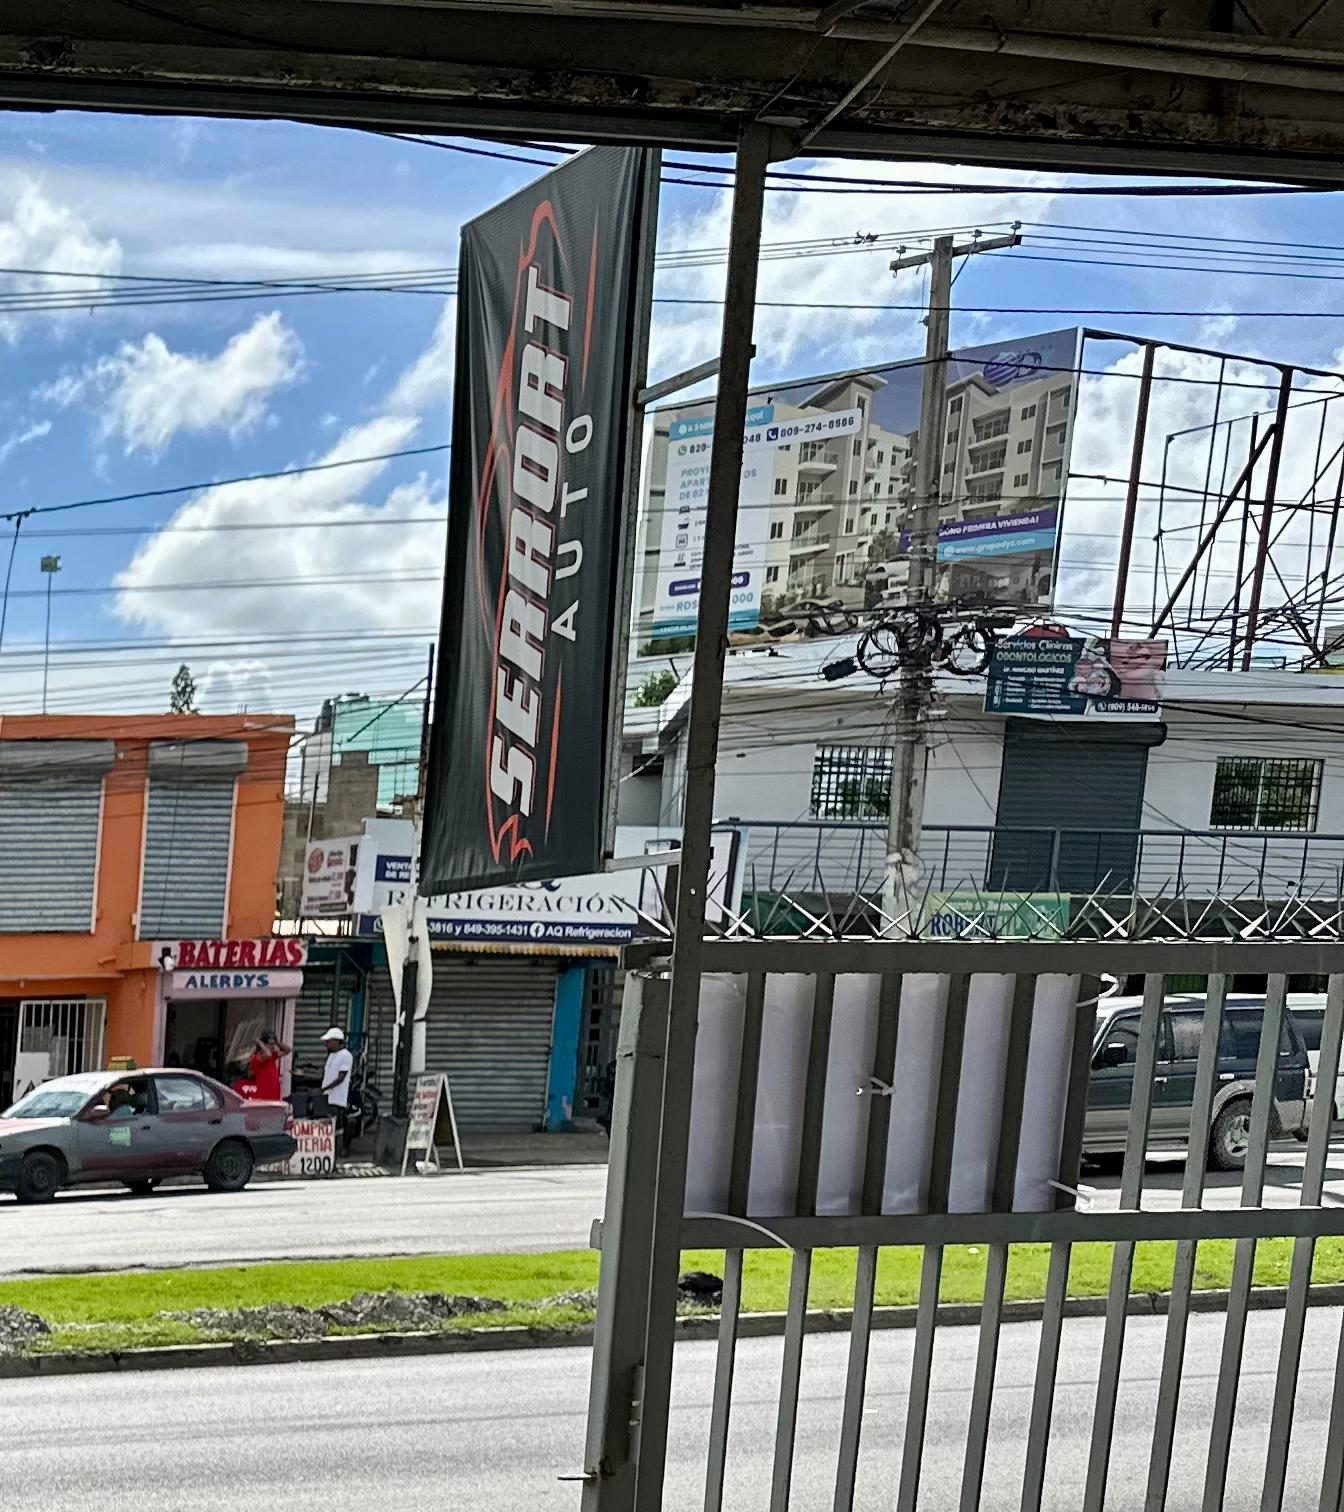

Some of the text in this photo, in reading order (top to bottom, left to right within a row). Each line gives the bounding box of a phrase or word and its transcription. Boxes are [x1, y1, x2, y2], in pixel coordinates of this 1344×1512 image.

[550, 411, 595, 643] AUTO
[489, 264, 574, 818] SERRORT
[387, 889, 626, 915] RFRIGERACIÓN
[546, 926, 563, 937] AQ
[565, 926, 632, 939] Refrigeracion
[178, 938, 303, 967] BATERIAS
[185, 974, 270, 989] ALERDYS
[300, 1156, 331, 1175] 1200
